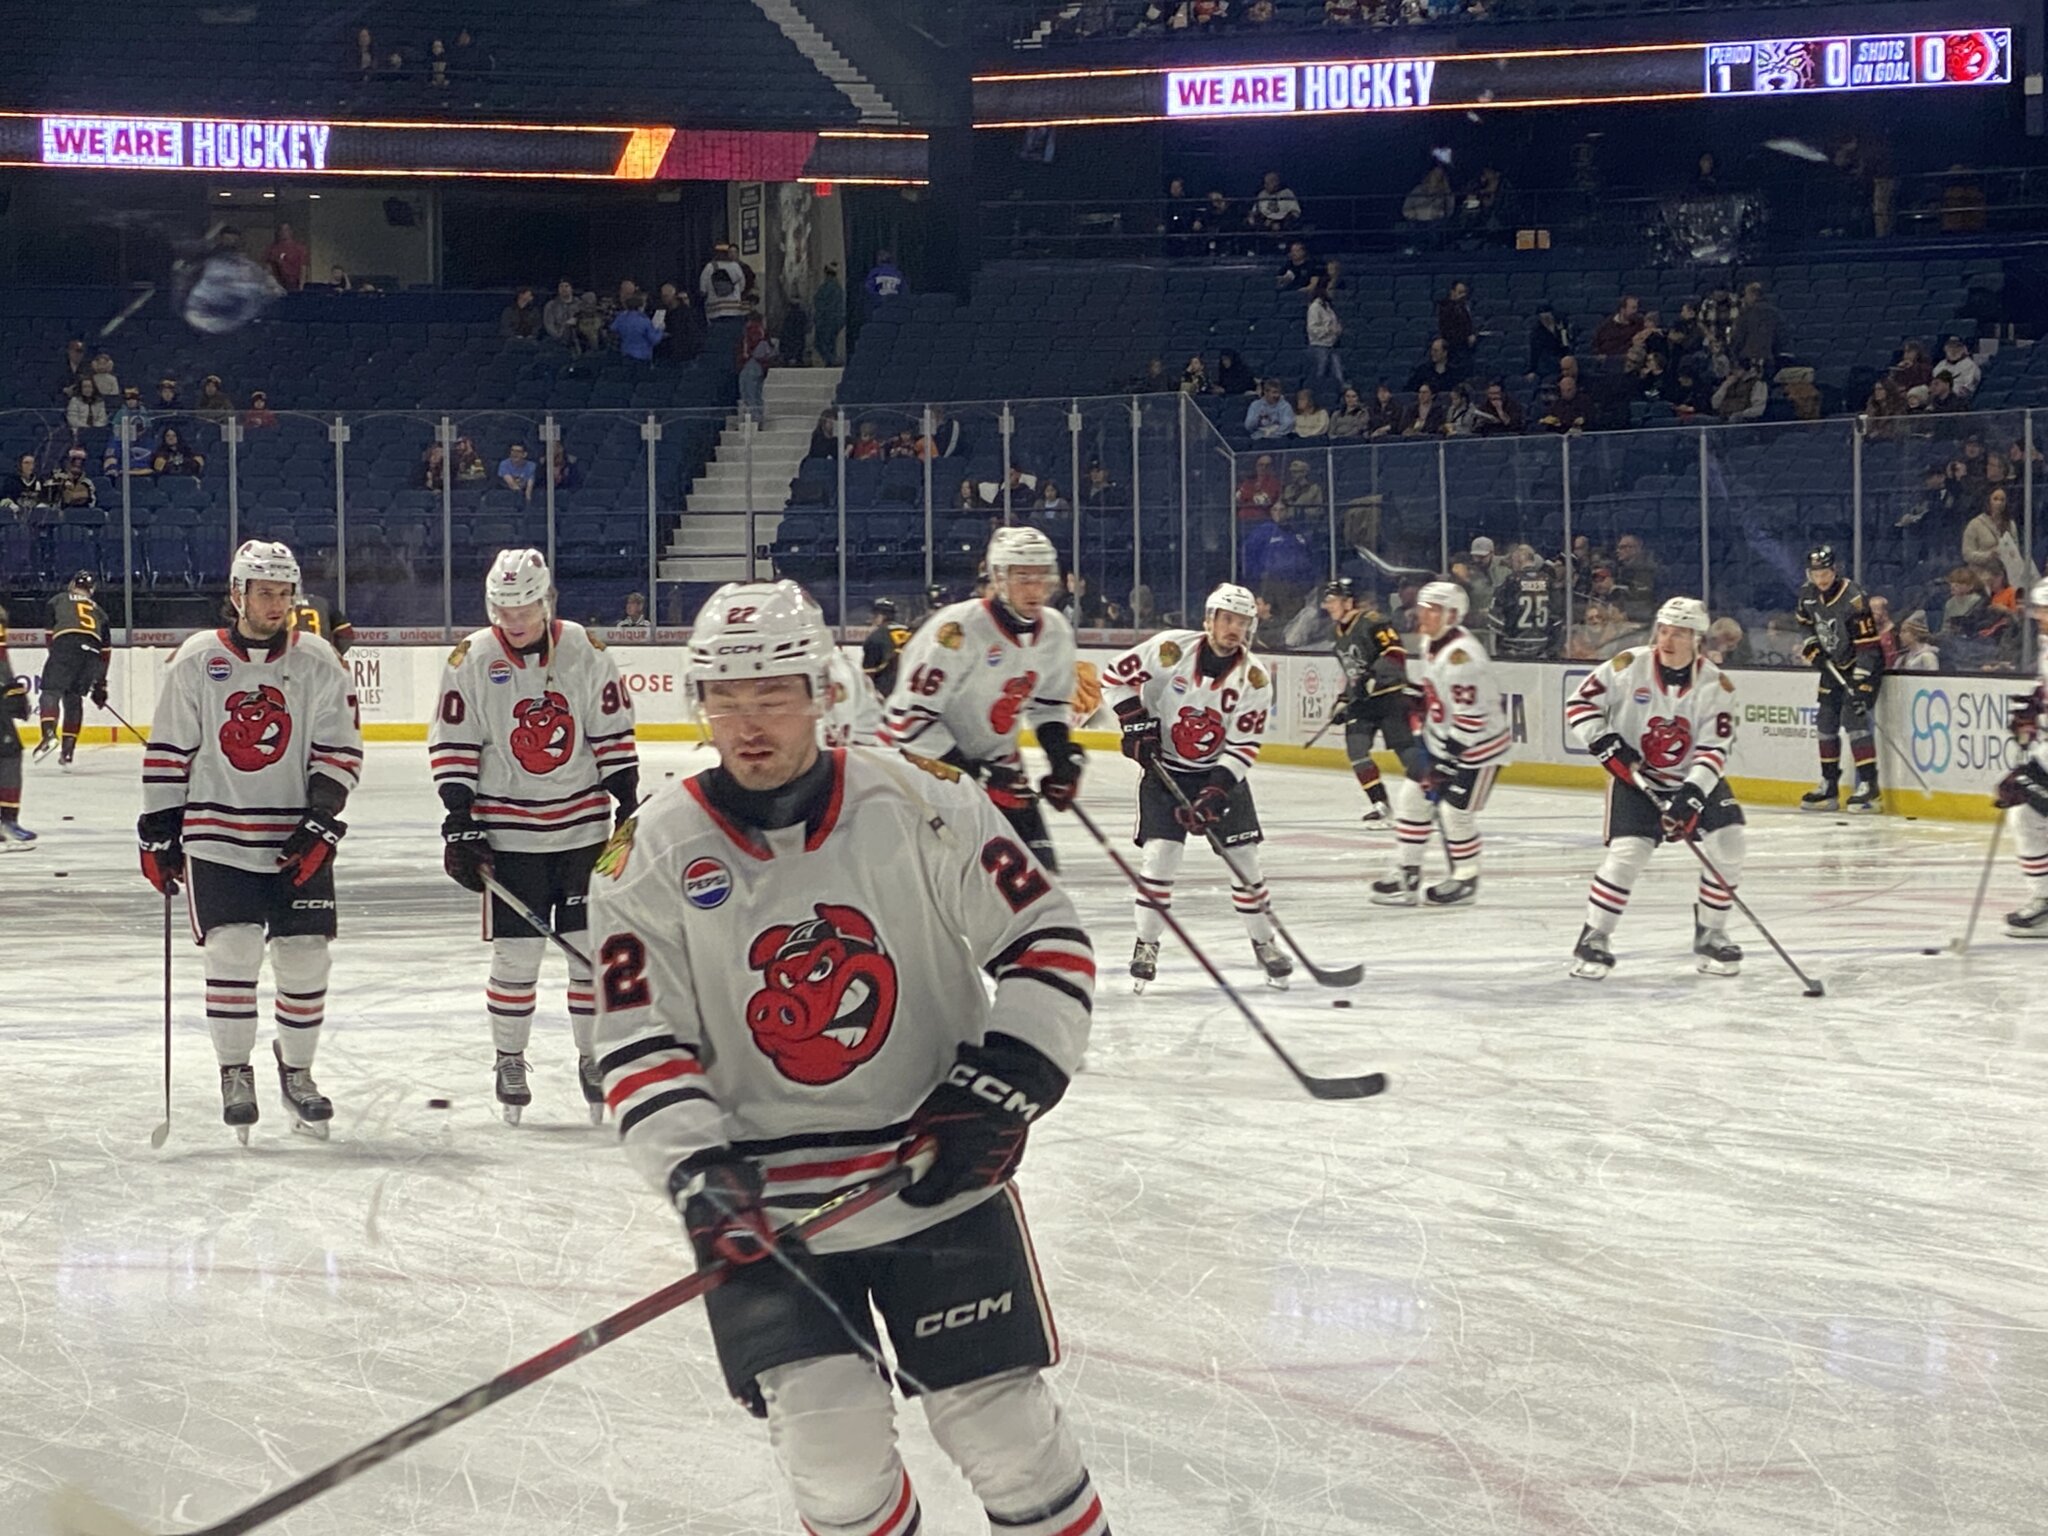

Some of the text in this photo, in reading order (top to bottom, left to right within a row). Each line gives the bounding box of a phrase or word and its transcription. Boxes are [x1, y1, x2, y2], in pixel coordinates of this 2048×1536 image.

[1710, 45, 1752, 65] PERIOD
[1859, 40, 1905, 61] SHOTS
[1923, 37, 1945, 81] 0
[1824, 43, 1846, 86] 0
[1853, 60, 1911, 82] ON GOAL
[1177, 61, 1435, 110] WE ARE HOCKEY
[1718, 64, 1731, 91] 1
[53, 122, 330, 169] WE ARE HOCKEY
[76, 602, 96, 629] 5
[726, 606, 757, 624] 22
[1518, 596, 1549, 628] 25
[133, 631, 175, 641] savers
[400, 626, 443, 641] unique
[607, 629, 648, 641] unique
[718, 644, 764, 655] CCM
[1221, 687, 1239, 713] C
[1123, 720, 1158, 733] CCM
[1226, 828, 1260, 844] CCM
[687, 874, 728, 891] PEPSI
[291, 900, 335, 910] CCM
[948, 1063, 1040, 1121] CCM
[914, 1291, 1013, 1338] CCM
